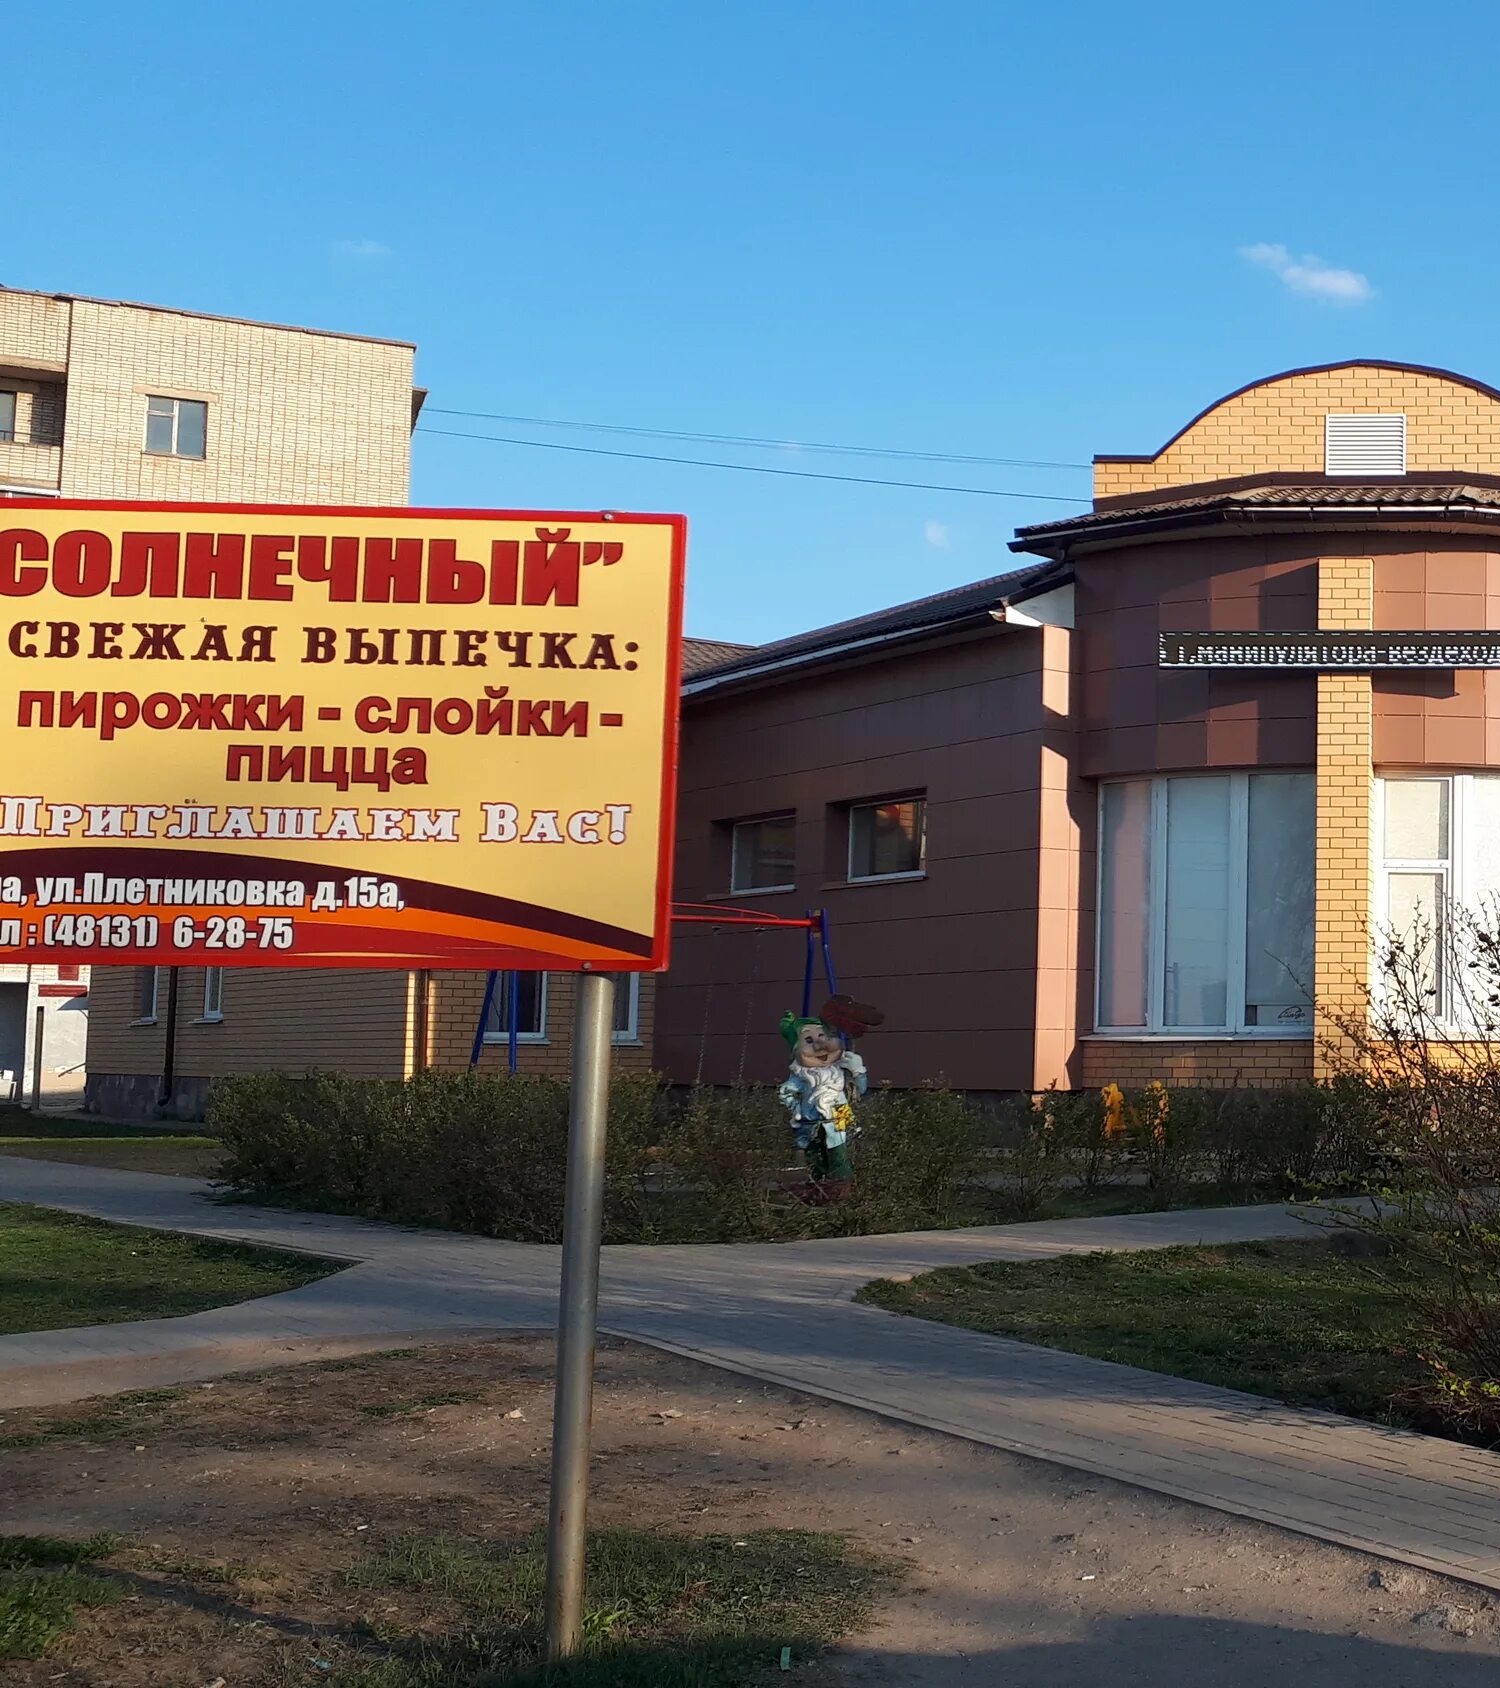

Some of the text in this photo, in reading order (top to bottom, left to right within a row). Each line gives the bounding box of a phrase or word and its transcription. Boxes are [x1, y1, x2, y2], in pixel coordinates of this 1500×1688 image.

[8, 620, 640, 672] СВЕЖАЯ ВЫПЕЧКА:
[17, 690, 304, 740] пирожки
[354, 685, 589, 738] слойки
[226, 743, 429, 792] пицца
[0, 872, 405, 913] а, ул.Плетниковка д.15а,
[43, 913, 159, 948] (48131)
[172, 914, 294, 950] 6-28-75
